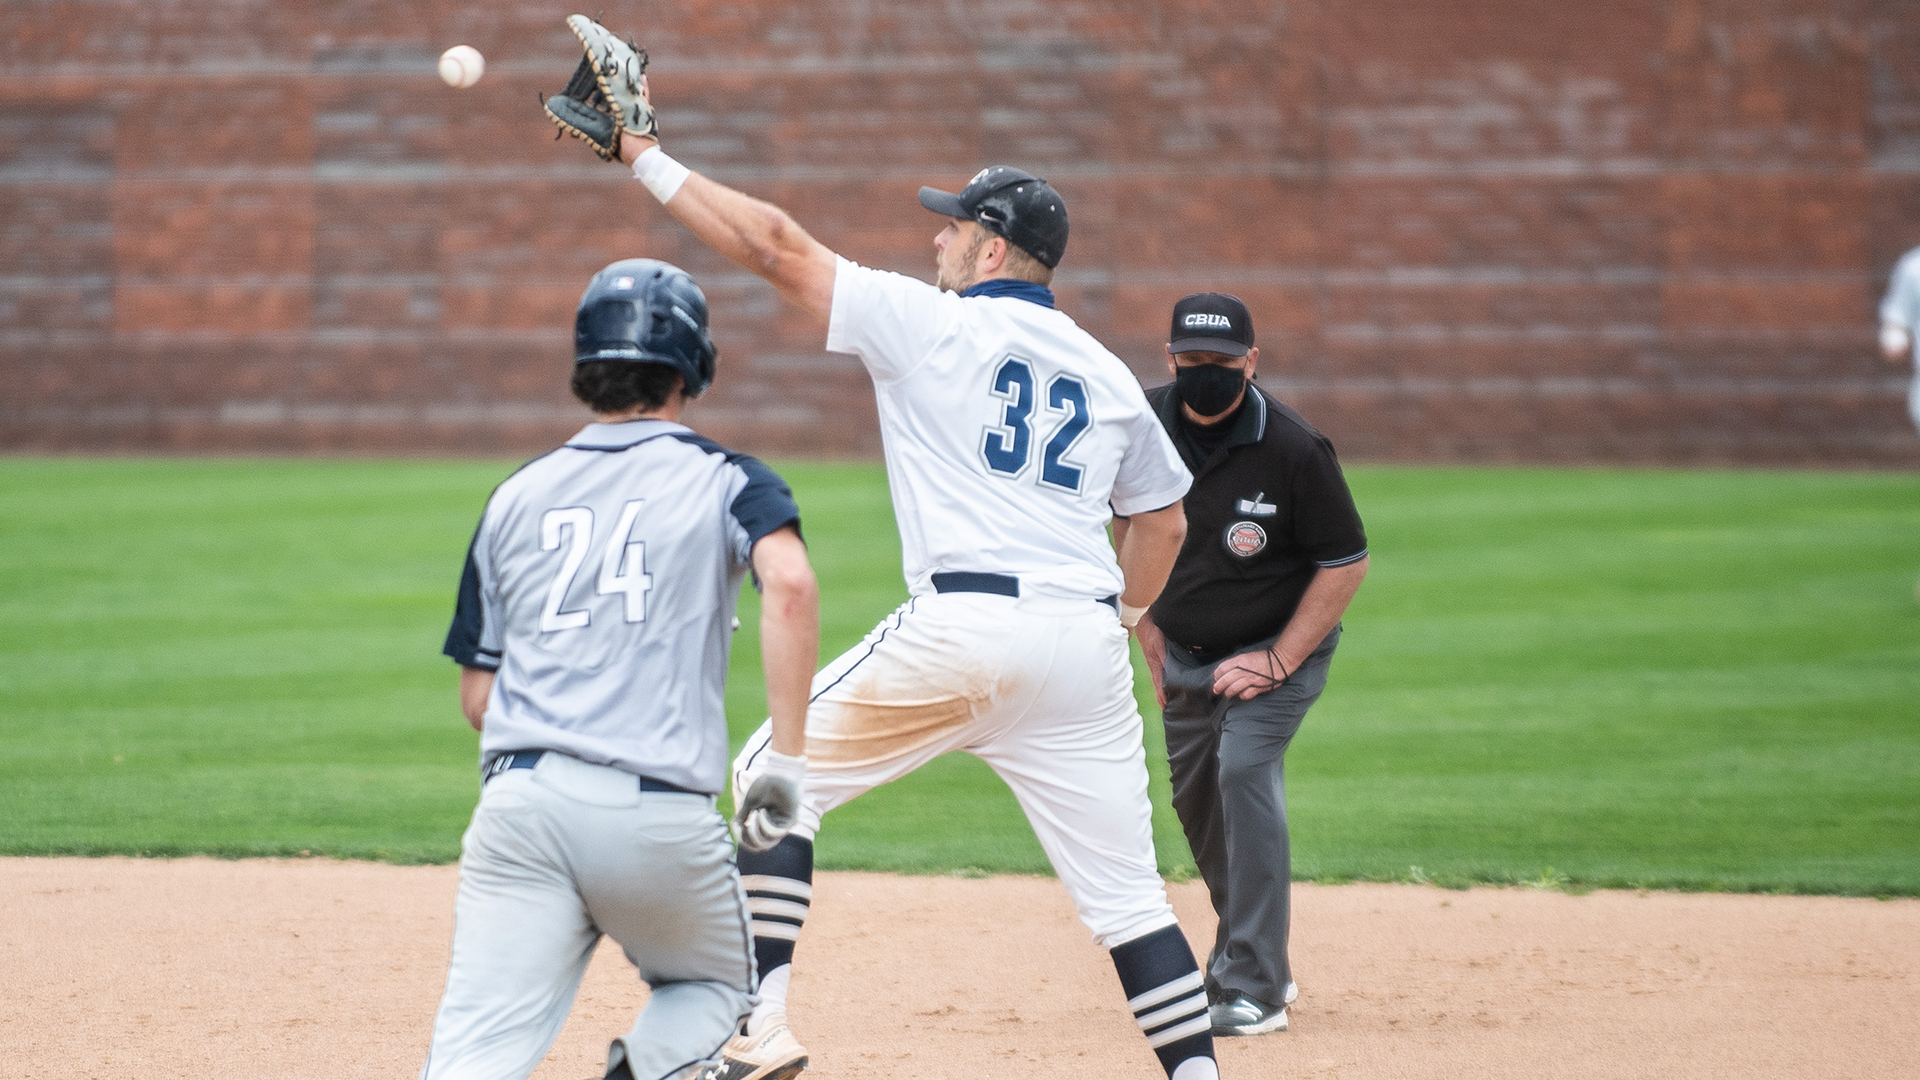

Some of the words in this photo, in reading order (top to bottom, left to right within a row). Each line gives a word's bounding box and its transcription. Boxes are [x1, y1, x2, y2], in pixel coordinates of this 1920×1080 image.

[1185, 313, 1231, 328] CBUA
[978, 352, 1095, 497] 32
[539, 499, 653, 634] 24
[760, 1028, 782, 1049] UNDER
